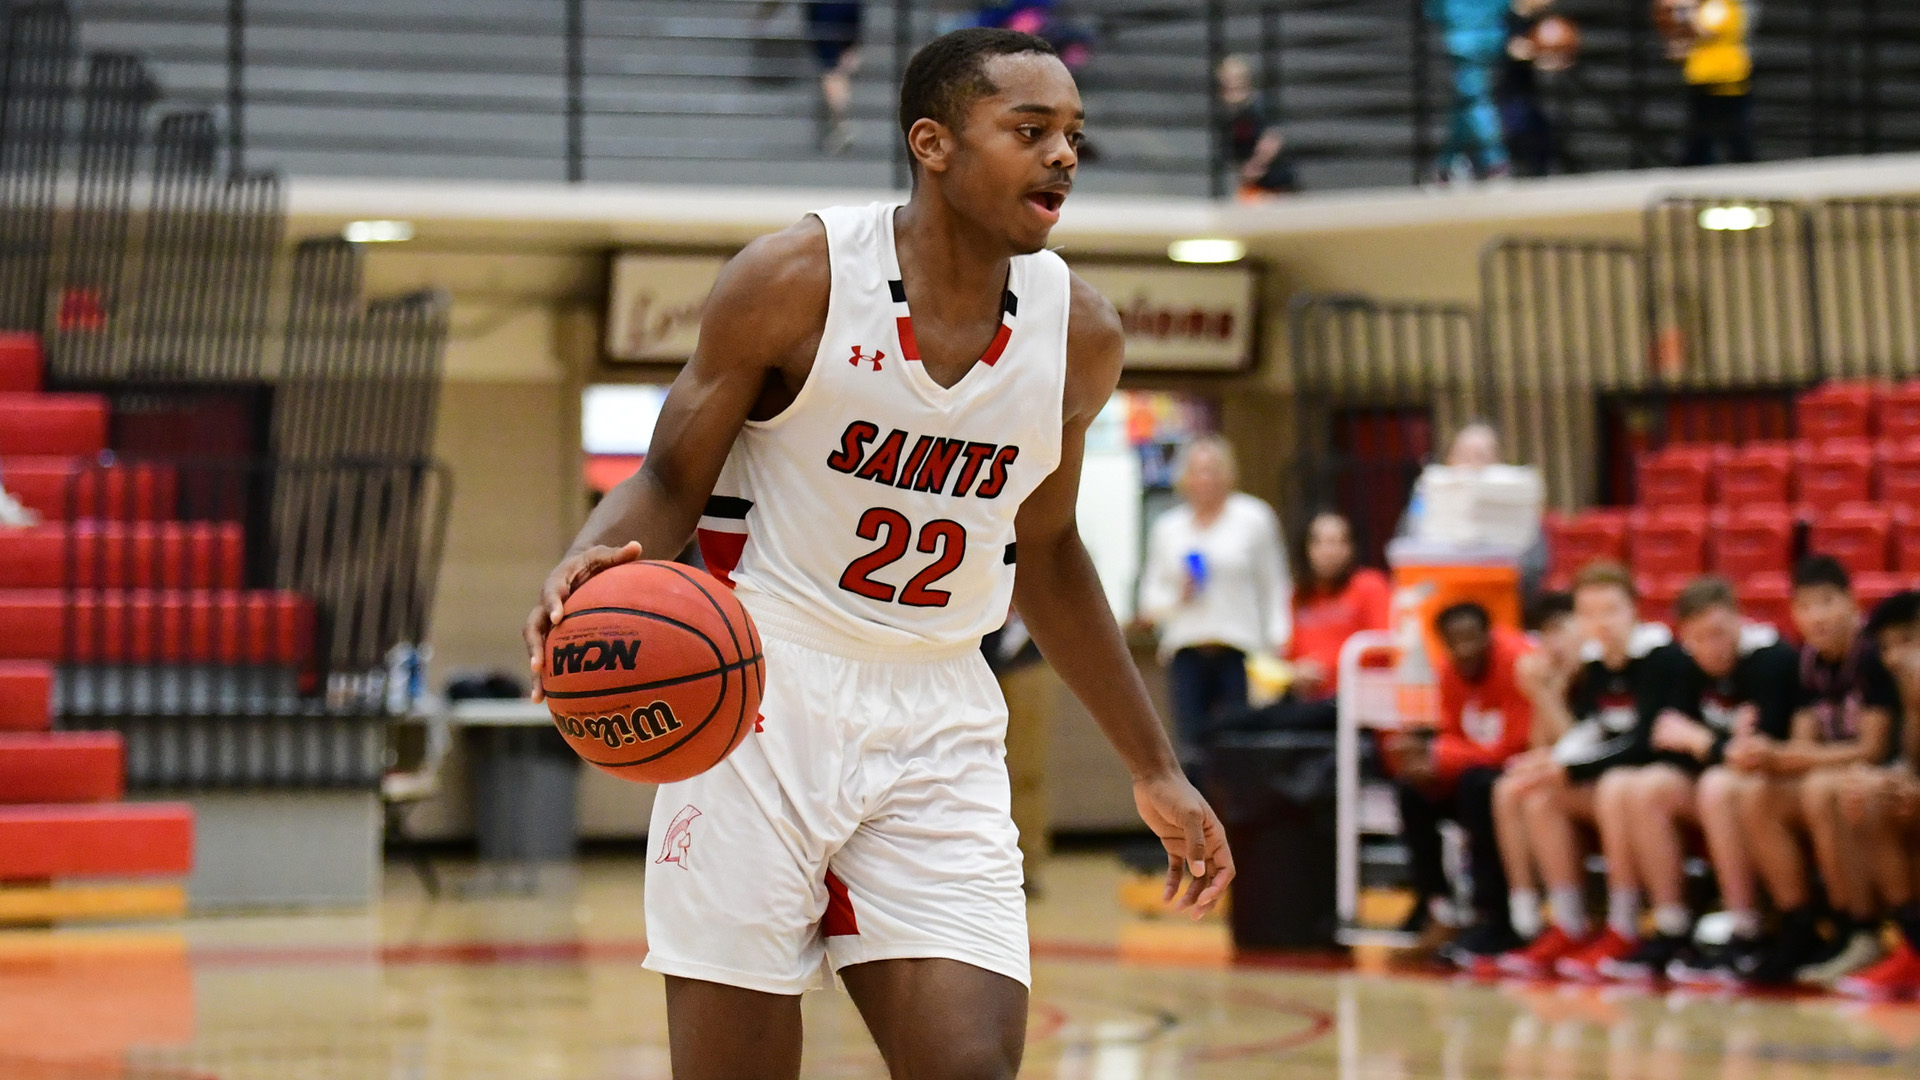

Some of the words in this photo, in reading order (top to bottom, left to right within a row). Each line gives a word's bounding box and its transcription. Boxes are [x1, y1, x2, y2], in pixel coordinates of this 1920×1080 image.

[827, 420, 1019, 499] SAINTS
[838, 507, 966, 607] 22
[552, 640, 641, 677] NCAA
[551, 700, 684, 749] Wilson
